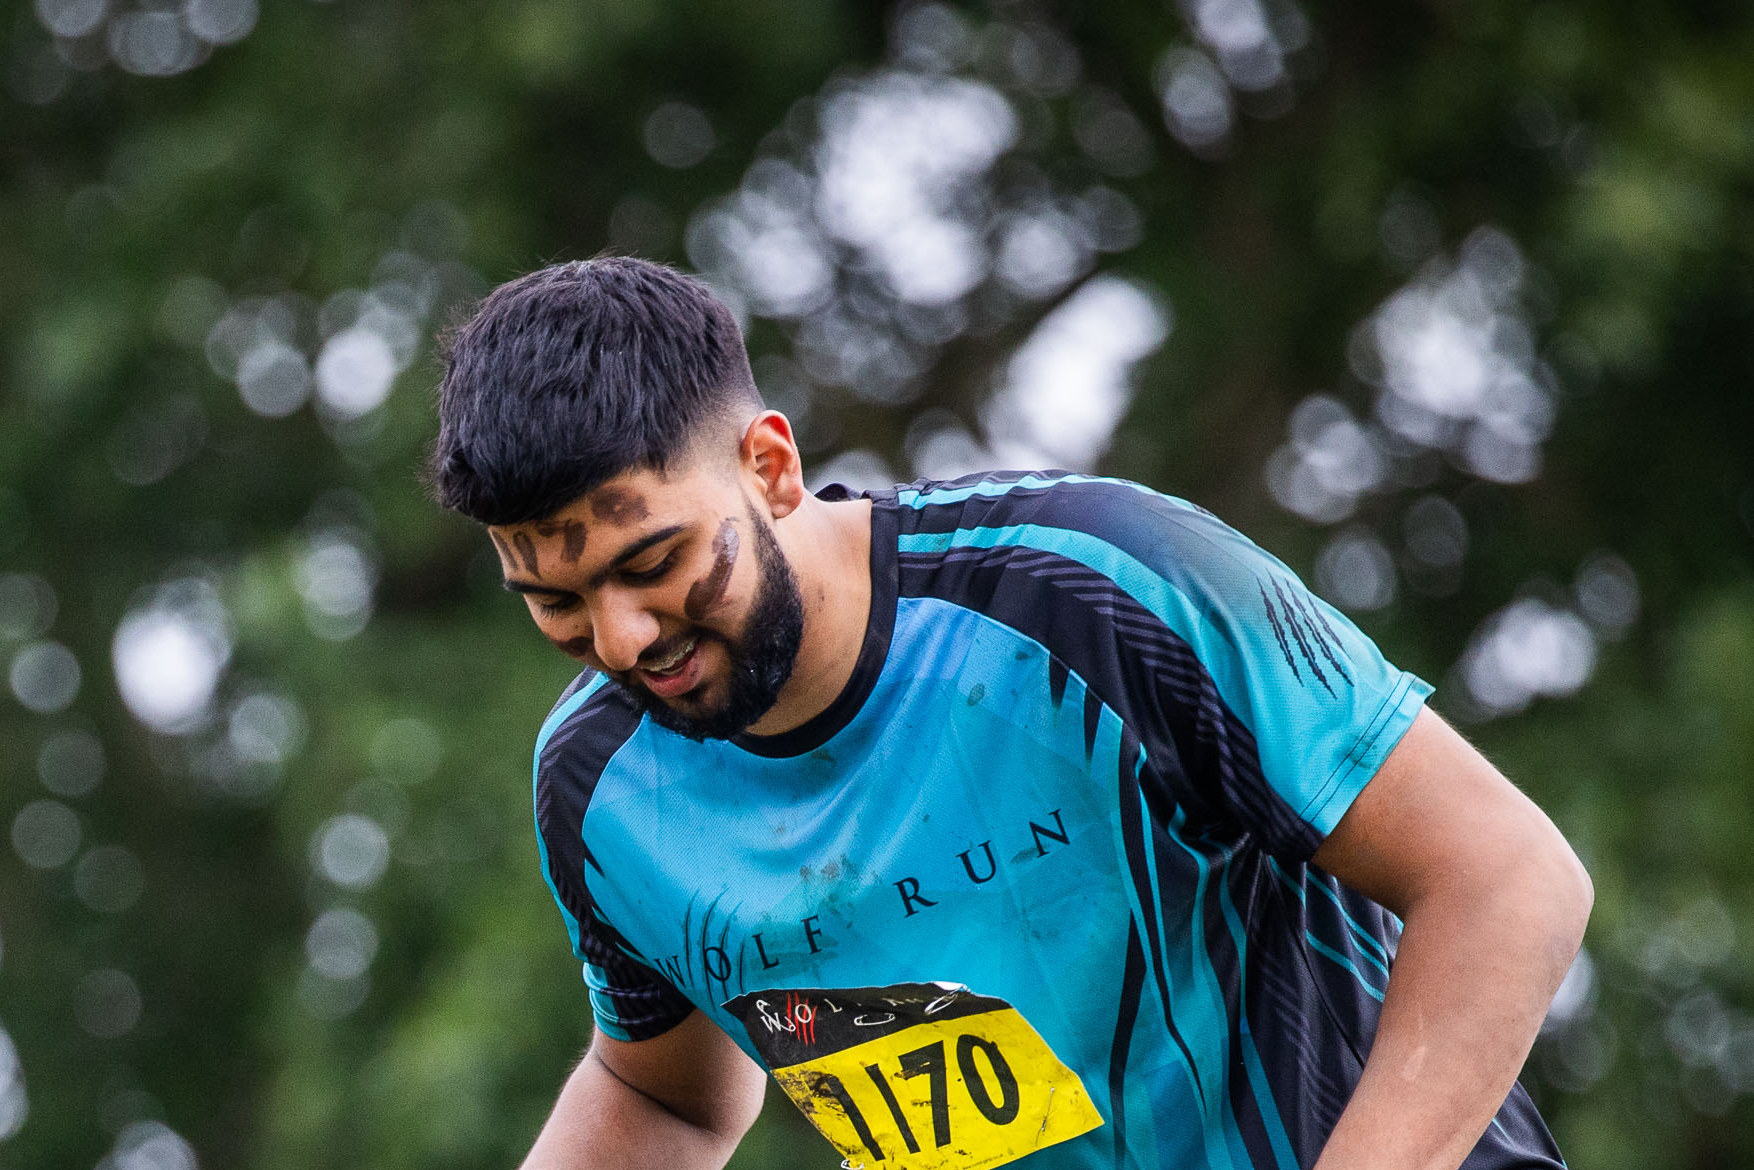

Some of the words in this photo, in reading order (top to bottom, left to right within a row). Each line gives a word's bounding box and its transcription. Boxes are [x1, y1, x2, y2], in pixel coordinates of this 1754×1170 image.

[654, 914, 823, 988] WOLF
[892, 808, 1071, 918] RUN
[761, 998, 862, 1034] WOL
[813, 1034, 1021, 1161] 1170
